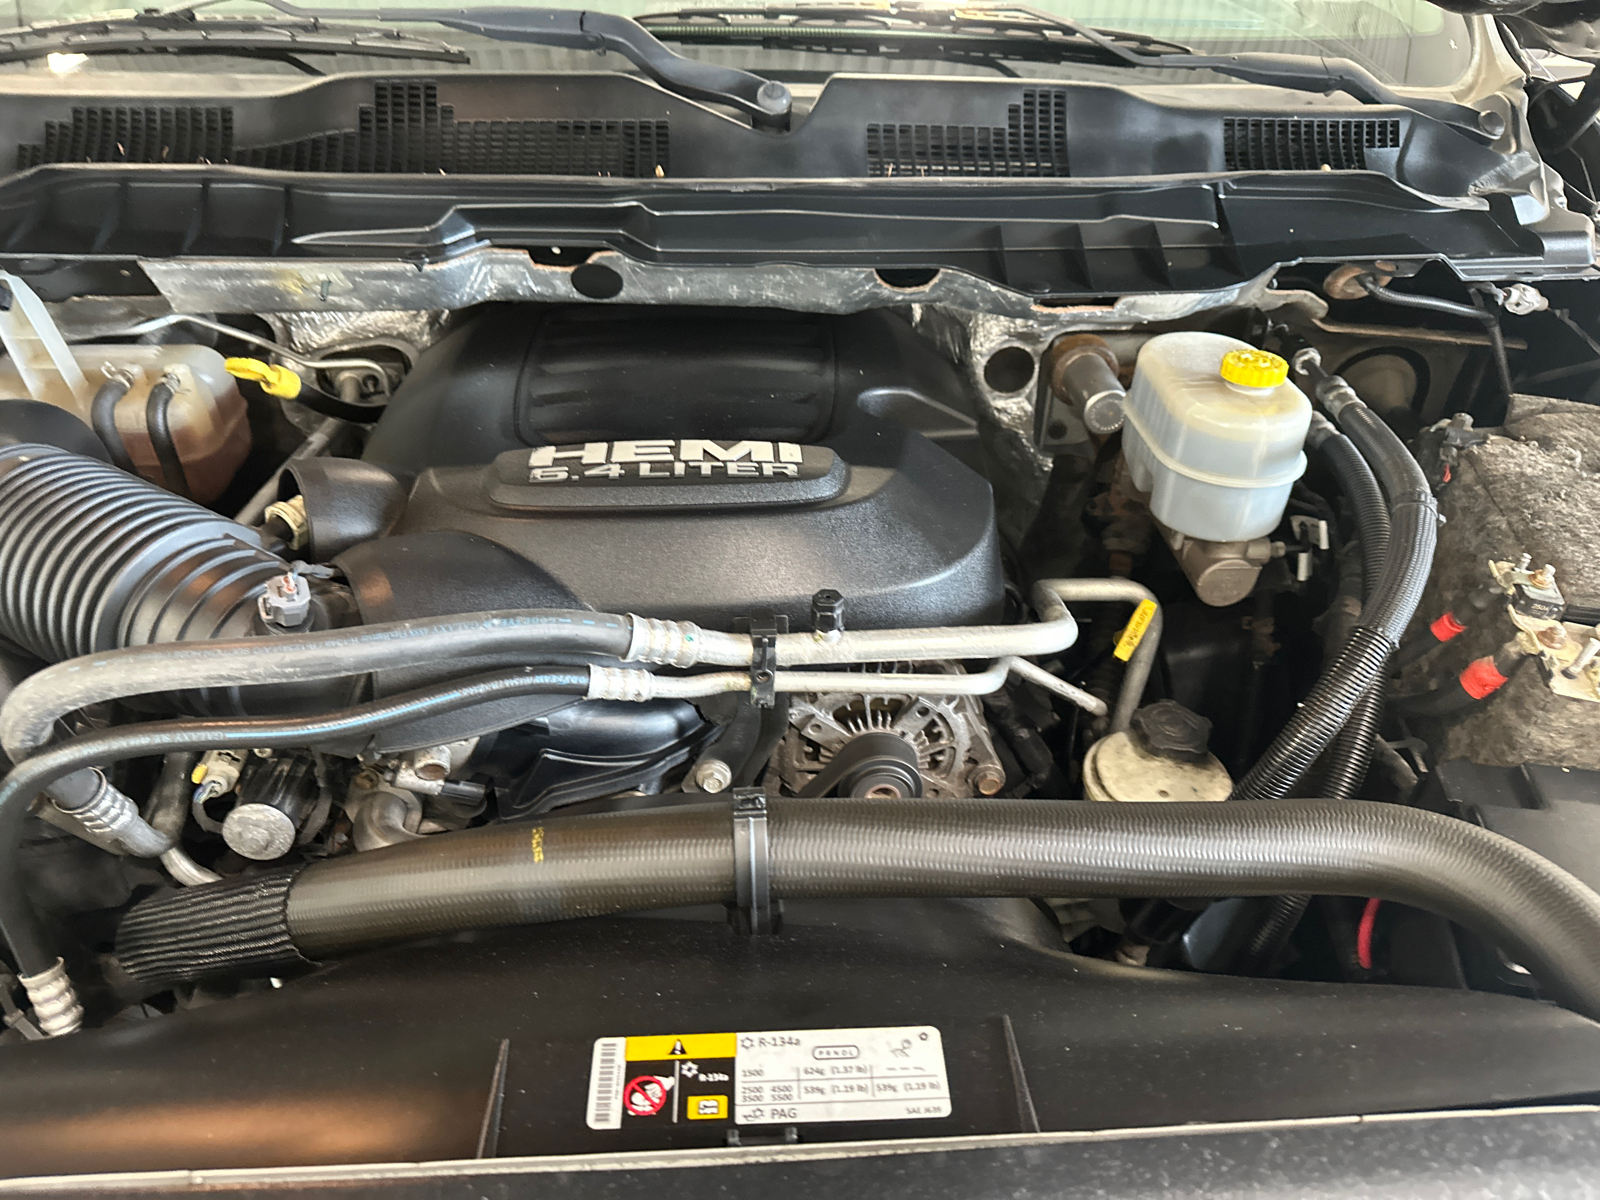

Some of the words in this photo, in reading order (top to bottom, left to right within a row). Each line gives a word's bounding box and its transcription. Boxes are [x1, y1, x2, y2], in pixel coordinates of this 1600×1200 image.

[528, 439, 803, 467] HEMI
[639, 461, 800, 479] LITER
[758, 1036, 801, 1048] R-134a
[741, 1068, 764, 1077] 1500
[741, 1086, 764, 1094] 2500
[770, 1084, 794, 1093] 4500
[770, 1093, 794, 1102] 5500
[770, 1107, 798, 1120] PAG
